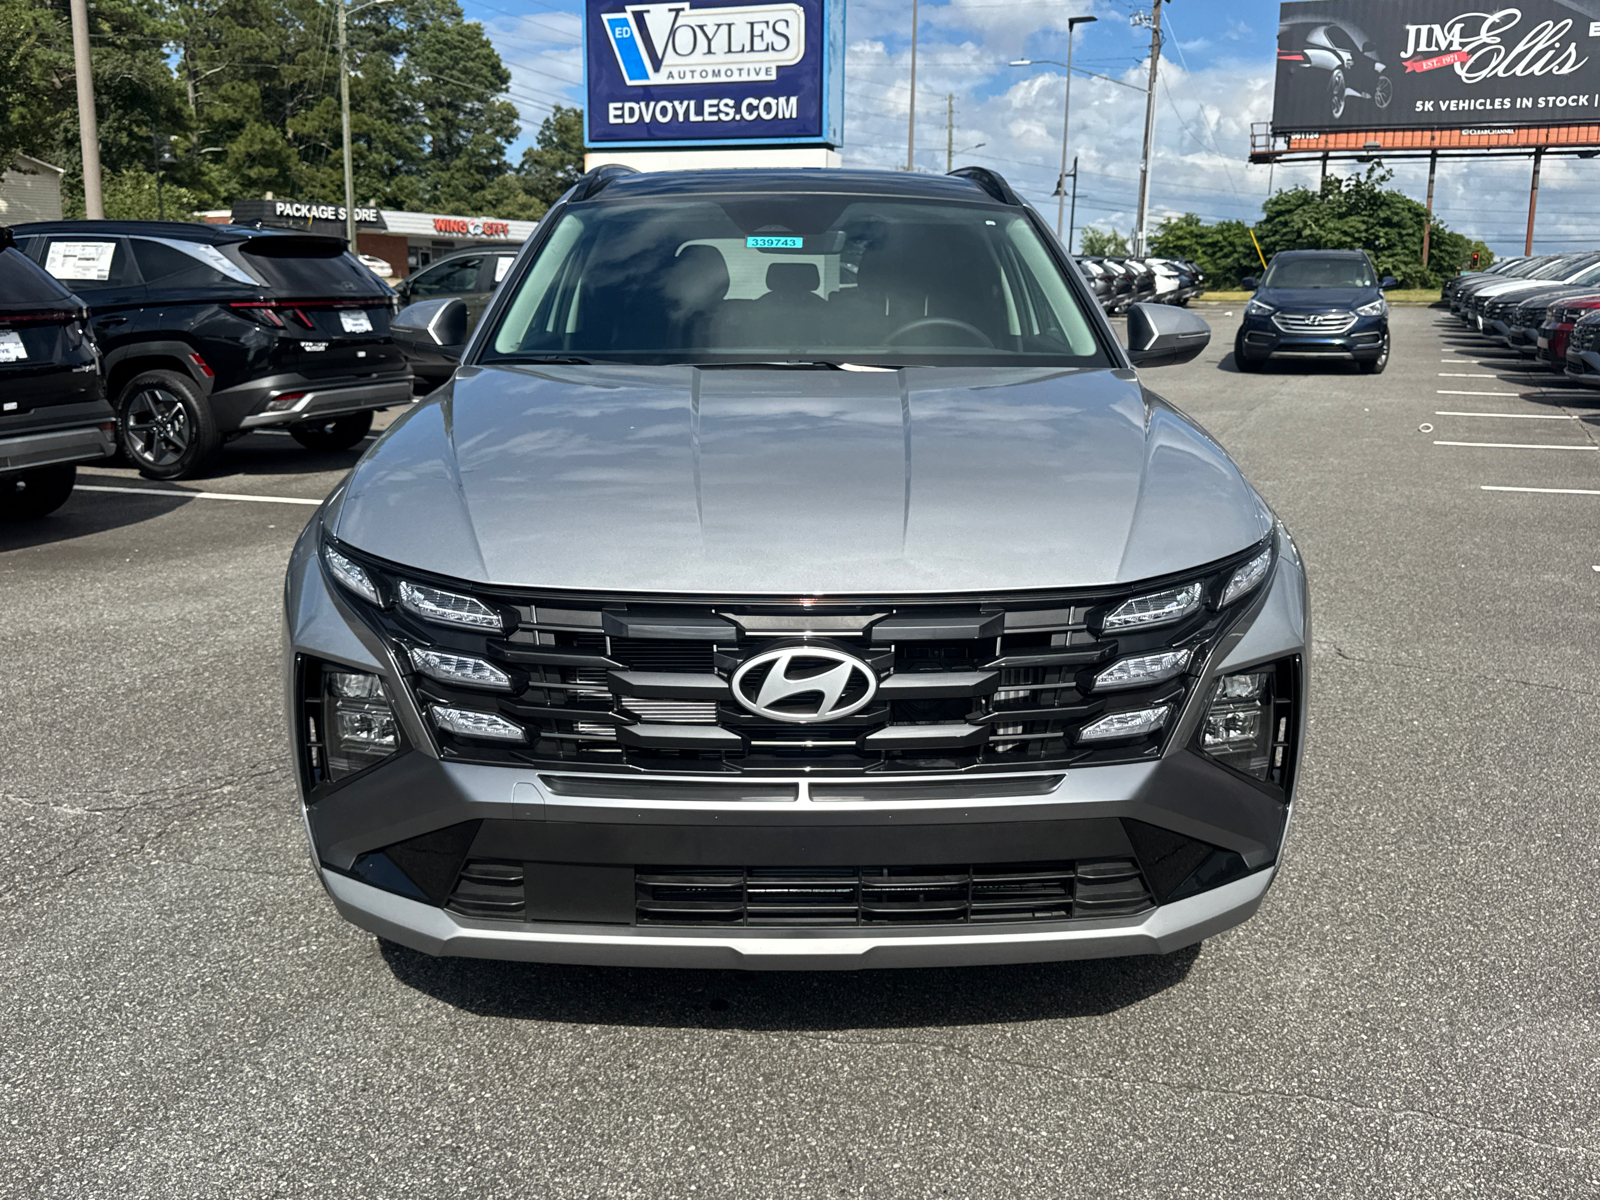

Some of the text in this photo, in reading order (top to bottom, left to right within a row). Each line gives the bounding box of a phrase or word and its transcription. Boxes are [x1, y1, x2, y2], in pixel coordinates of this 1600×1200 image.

[615, 7, 791, 73] ED VOYLES
[1400, 8, 1589, 84] JIM Ellis
[1422, 53, 1459, 70] EST. 1971
[666, 66, 773, 80] AUTOMOTIVE
[608, 95, 798, 124] EDVOYLES.COM
[1415, 100, 1434, 112] 5K
[1439, 98, 1511, 111] VEHICLES
[1516, 97, 1533, 109] IN
[1537, 94, 1589, 108] STOCK
[275, 202, 378, 222] PACKAGE SORE
[433, 218, 510, 236] WING CITY
[751, 238, 797, 247] 339743
